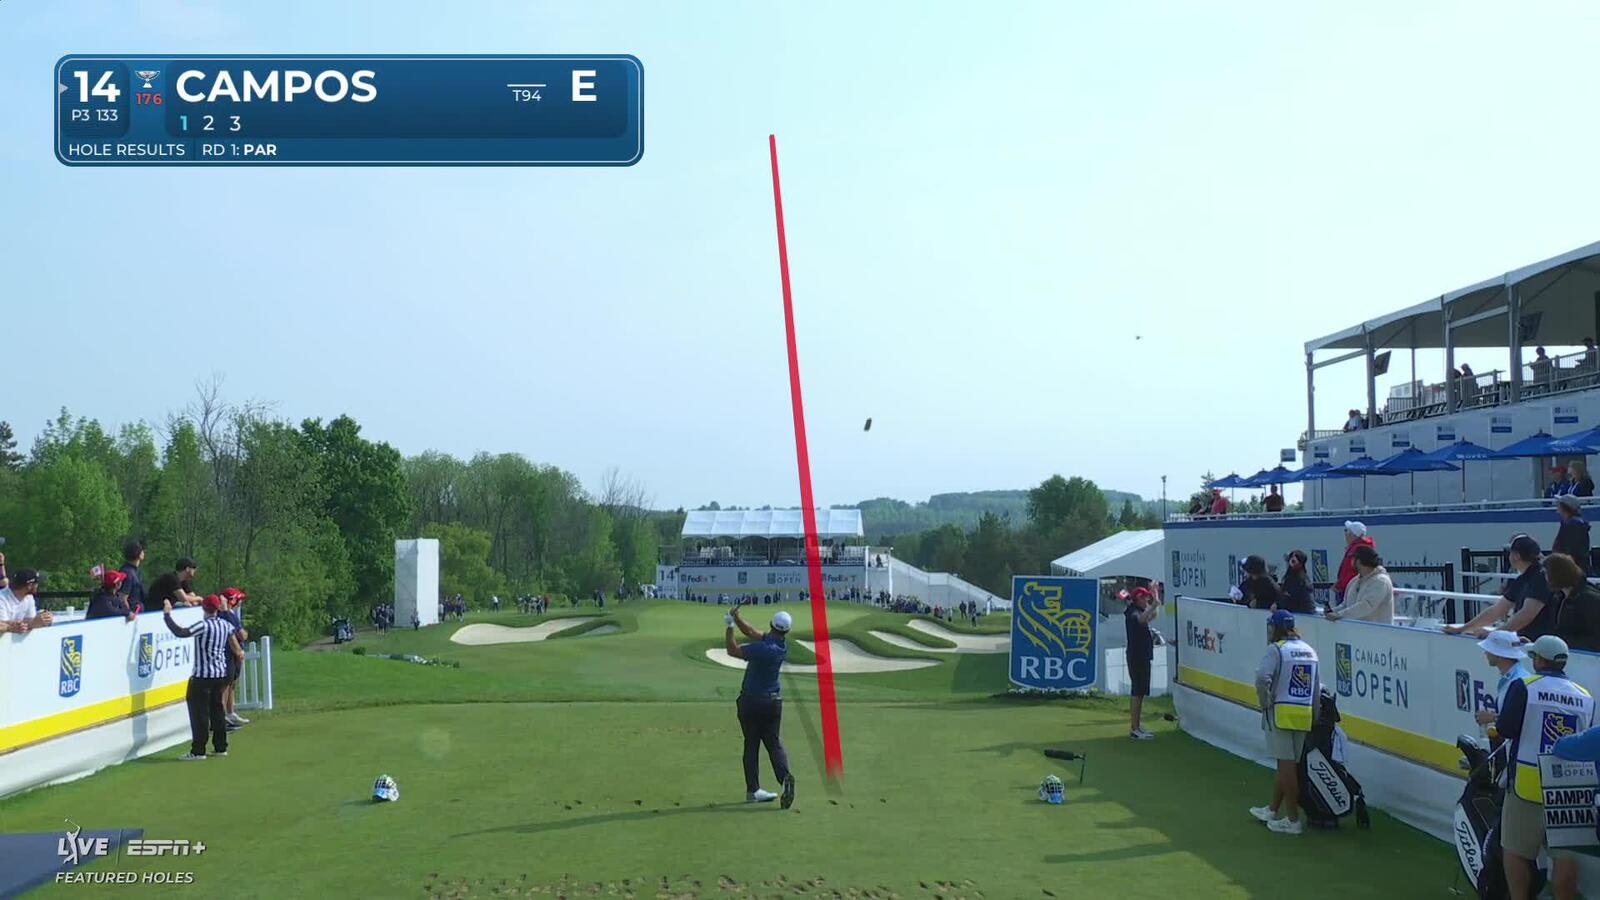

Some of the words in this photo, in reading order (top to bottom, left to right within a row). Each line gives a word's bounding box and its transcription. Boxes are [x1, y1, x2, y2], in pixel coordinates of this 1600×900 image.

[660, 569, 675, 581] 14
[1181, 567, 1207, 588] OPEN
[154, 645, 190, 671] OPEN
[1355, 646, 1408, 673] CANADIAN
[1020, 655, 1087, 682] RBC
[61, 677, 80, 695] RBC
[1290, 687, 1311, 696] RBC
[1356, 669, 1409, 710] OPEN
[1538, 690, 1584, 708] MALNATI
[1564, 768, 1594, 777] OPEN
[1309, 760, 1347, 808] Titleist
[1546, 789, 1593, 805] CAMPO
[1546, 810, 1595, 825] MALNA
